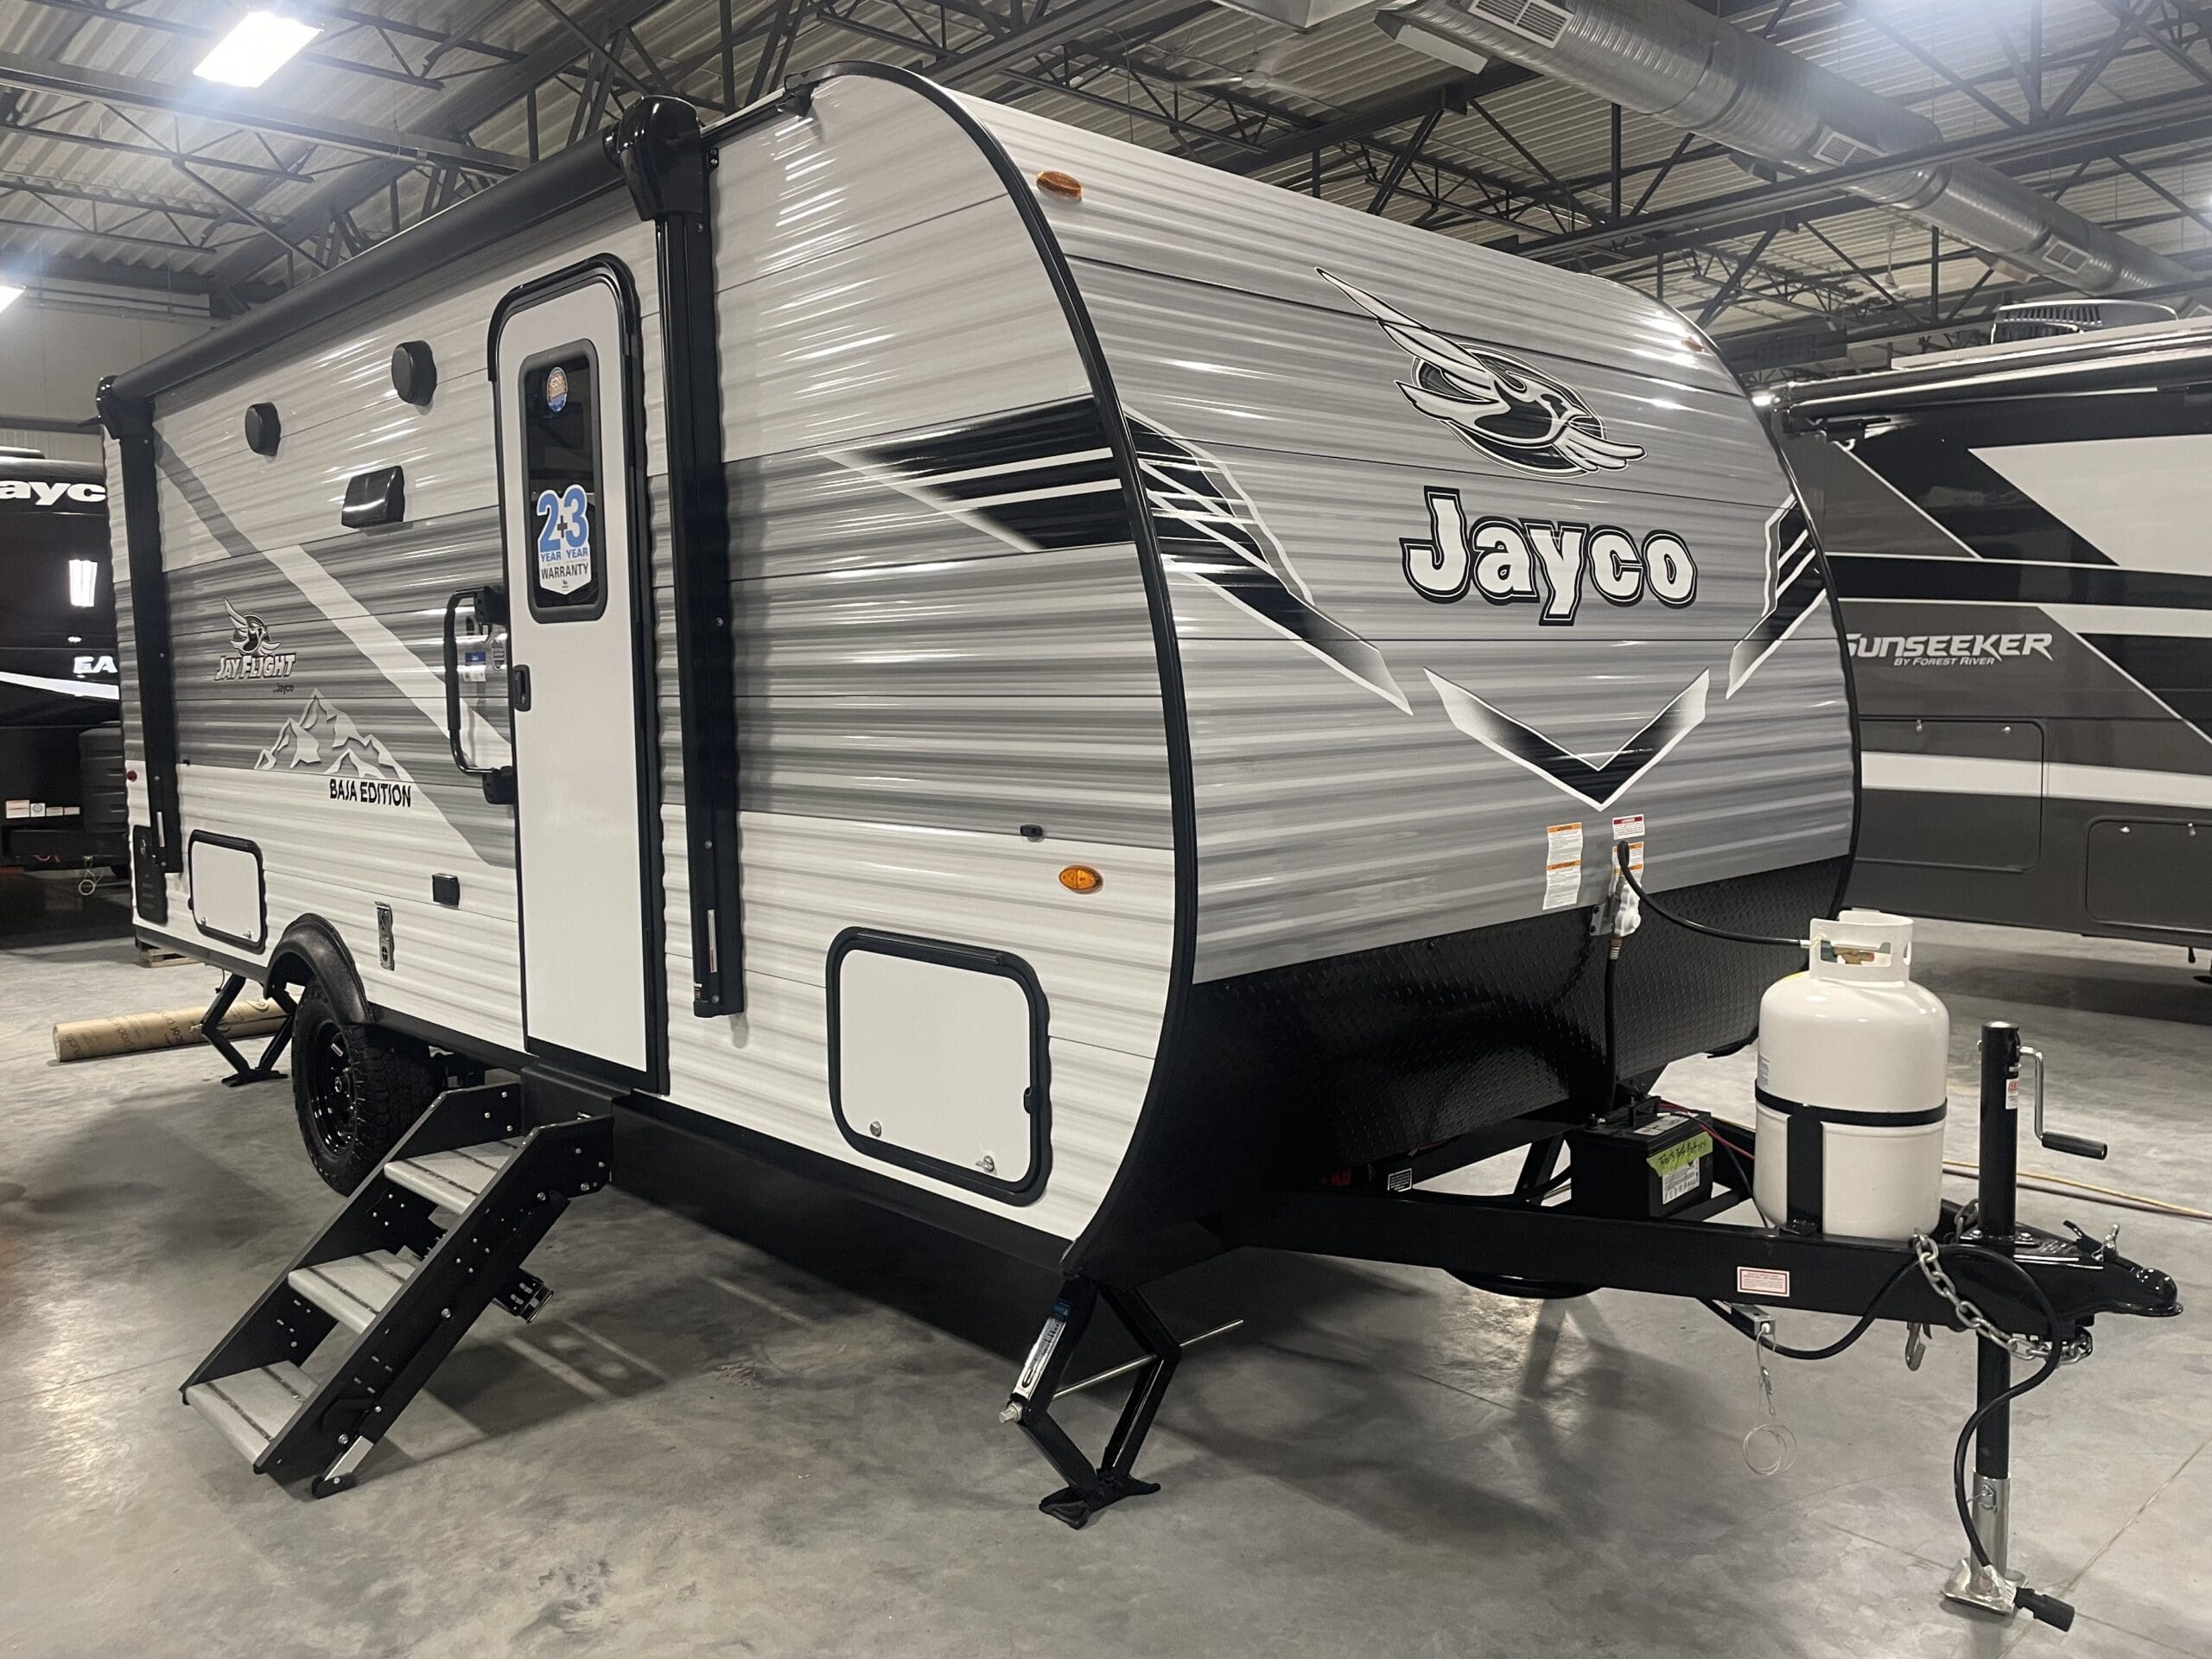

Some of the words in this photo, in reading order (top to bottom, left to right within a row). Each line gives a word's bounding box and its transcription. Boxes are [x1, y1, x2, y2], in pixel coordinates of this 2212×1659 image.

[0, 480, 106, 505] ayc
[540, 551, 562, 563] YEAR
[566, 547, 588, 560] YEAR
[1399, 486, 1698, 626] Jayco
[541, 562, 589, 580] WARRANTY
[73, 655, 118, 674] EA
[214, 655, 242, 681] JAY
[239, 652, 296, 679] FLIGHT
[1912, 657, 1957, 666] FOREST
[1959, 657, 1995, 665] RIVER
[329, 779, 358, 802] BAJA
[359, 781, 412, 808] EDITION
